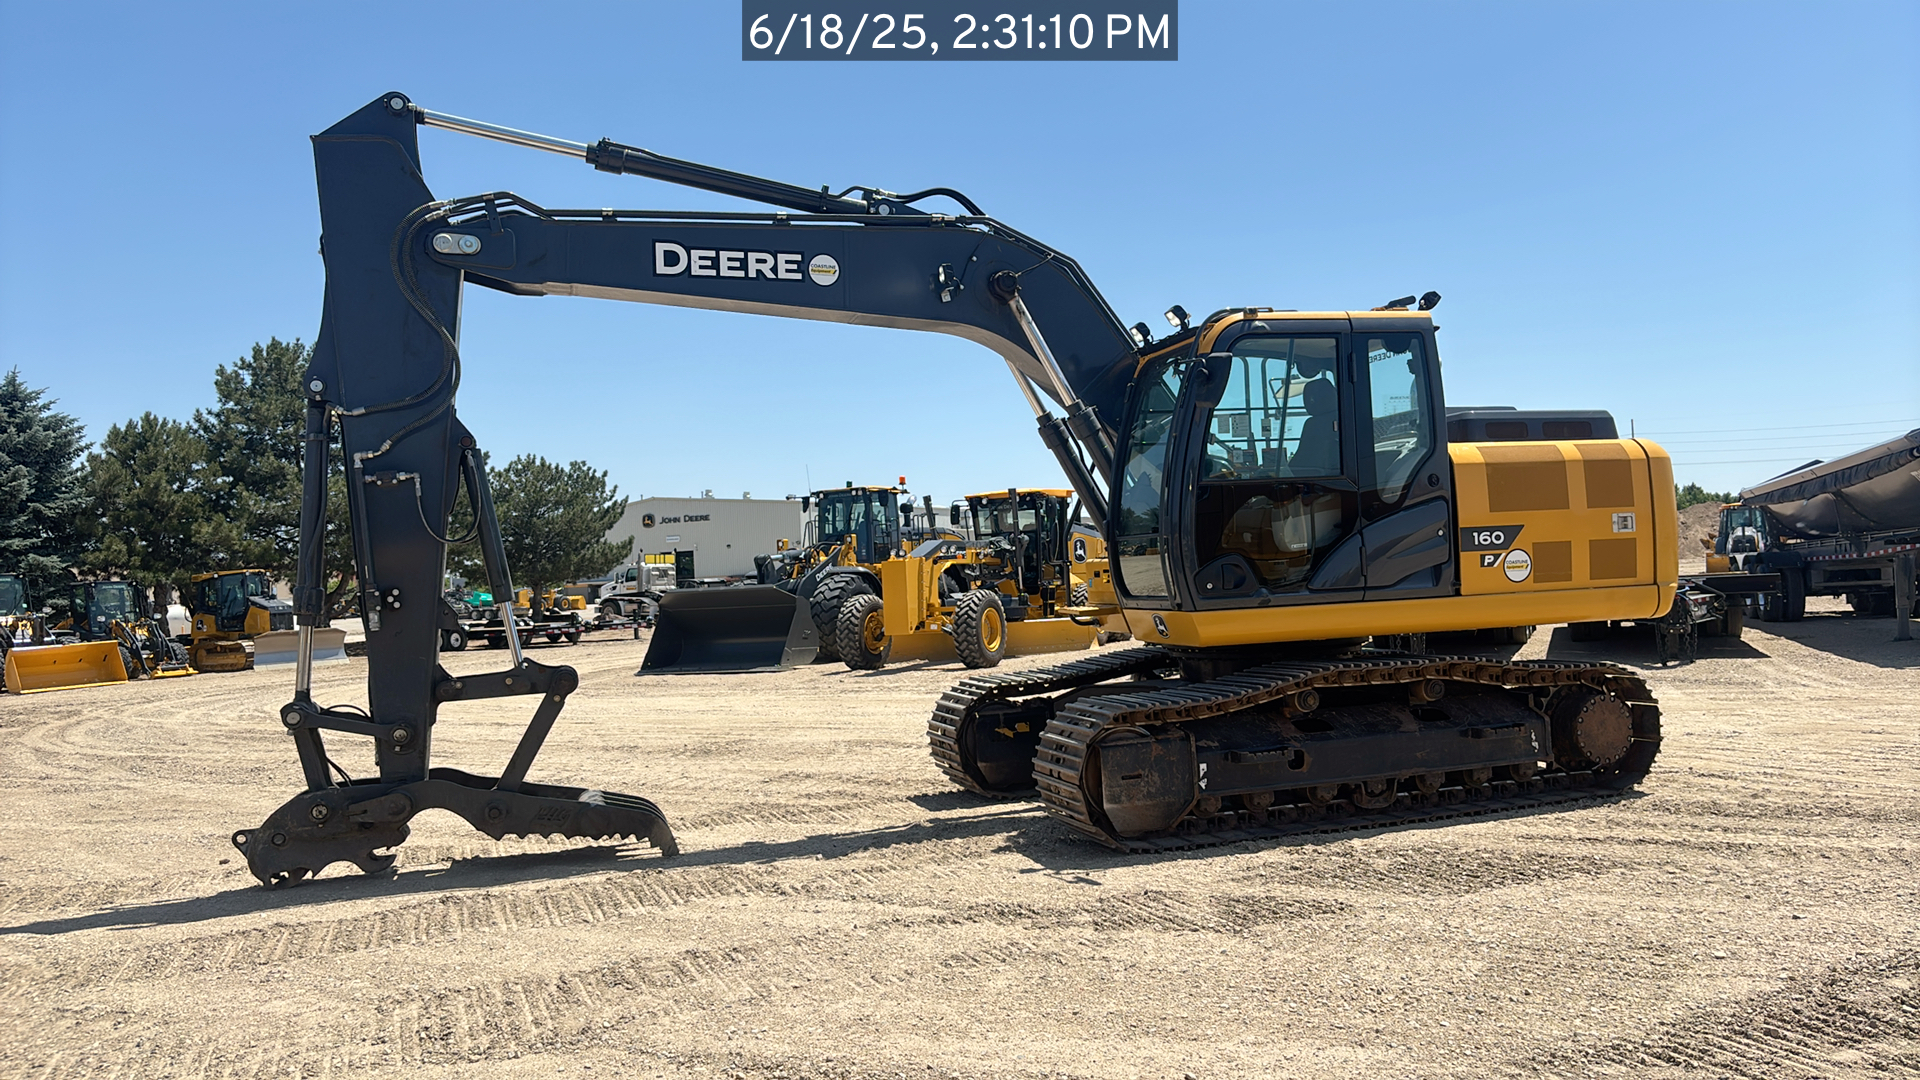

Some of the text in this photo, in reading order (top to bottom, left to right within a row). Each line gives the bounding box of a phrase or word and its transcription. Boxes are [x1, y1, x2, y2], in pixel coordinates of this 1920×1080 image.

[655, 242, 803, 280] DEERE
[659, 514, 710, 524] JOHN DEERE
[1472, 531, 1505, 545] 160
